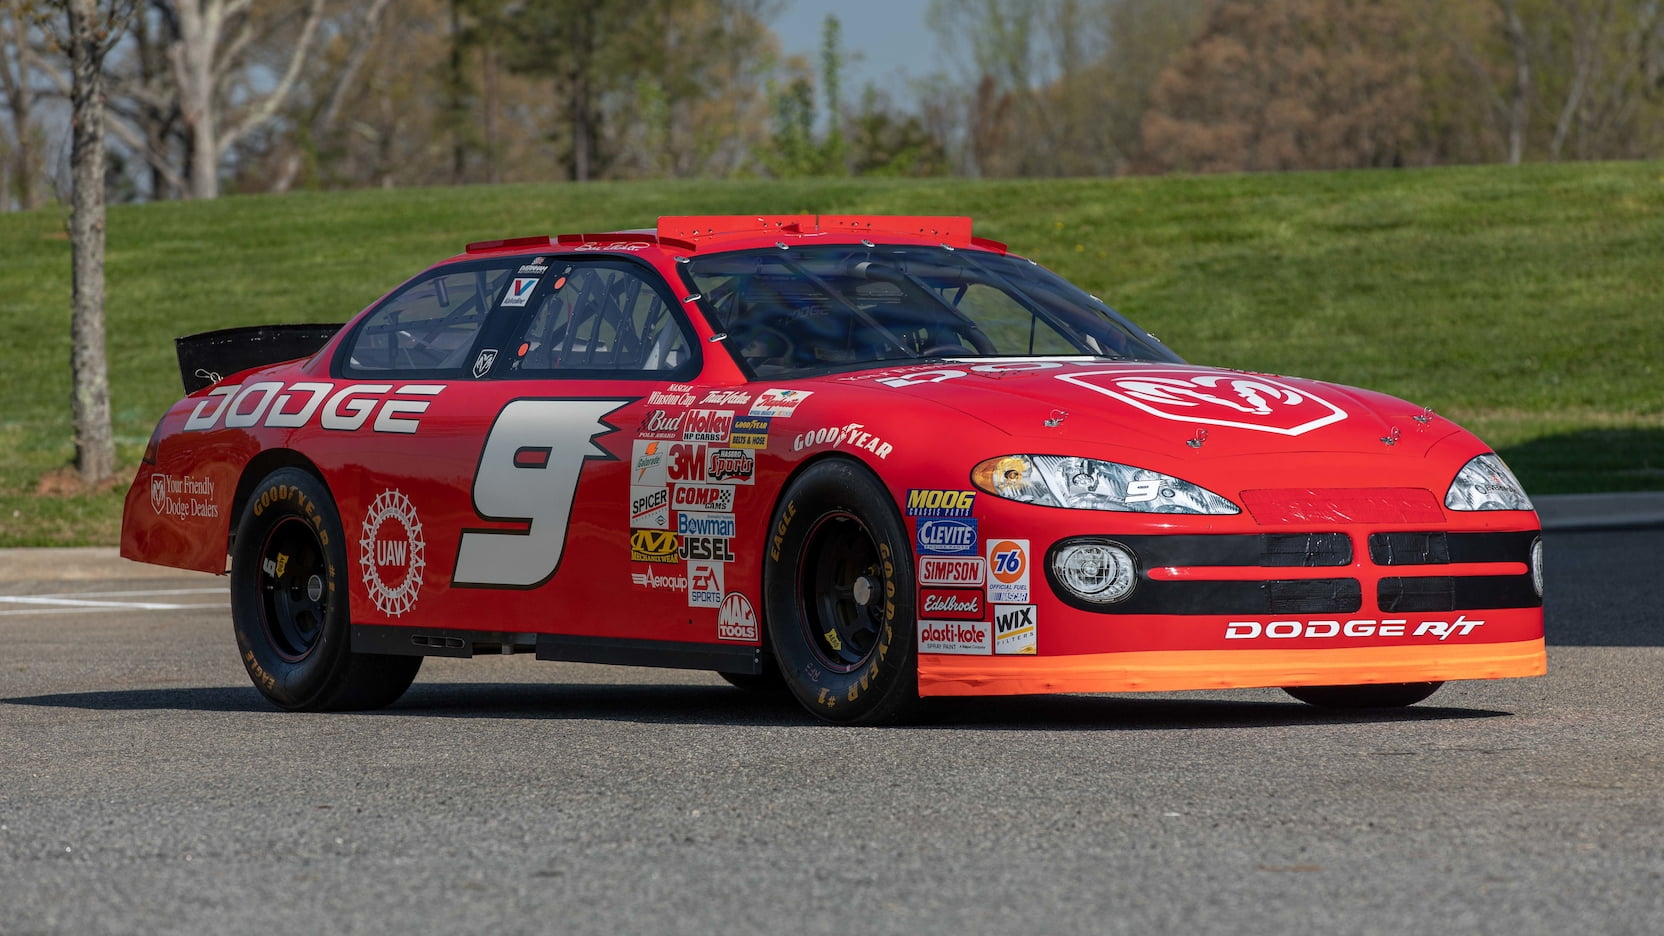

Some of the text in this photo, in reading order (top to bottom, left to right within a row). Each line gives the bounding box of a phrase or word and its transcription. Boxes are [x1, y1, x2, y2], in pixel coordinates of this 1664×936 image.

[647, 391, 696, 407] Winston Cup
[667, 383, 694, 392] NASCAR
[183, 381, 447, 434] DODGE
[647, 409, 686, 431] Bud
[685, 411, 732, 440] Holley
[734, 418, 768, 431] GOODYEAR
[695, 433, 720, 441] CARBS
[732, 434, 745, 444] BELTS
[751, 435, 766, 445] HOSE
[793, 422, 893, 460] GOODYEAR
[668, 444, 705, 481] 3M
[709, 453, 752, 477] Sports
[166, 474, 215, 500] Your Friendly
[450, 396, 646, 590] 9
[675, 486, 720, 505] COMP
[907, 490, 976, 508] MOOG
[1124, 480, 1166, 503] 9
[166, 500, 219, 520] Dodge Dealers
[632, 488, 667, 514] SPICER
[909, 508, 970, 516] CHASSIS PARTS
[253, 484, 330, 546] GOODYEAR
[678, 513, 735, 537] Bowman
[770, 500, 797, 562] EAGLE
[920, 521, 971, 545] CLEVITE
[377, 540, 407, 567] UAW
[679, 537, 734, 561] JESEL
[924, 561, 980, 581] SIMPSON
[994, 550, 1021, 575] 76
[643, 564, 687, 592] Aeroquip
[692, 566, 720, 591] EA
[691, 592, 721, 602] SPORTS
[924, 595, 978, 613] Edelbrock
[720, 595, 753, 627] MAC
[996, 607, 1033, 633] WIX
[719, 625, 755, 638] TOOLS
[996, 632, 1035, 646] FILTERS
[1224, 615, 1486, 641] DODGE R/T
[245, 650, 277, 690] EAGLE
